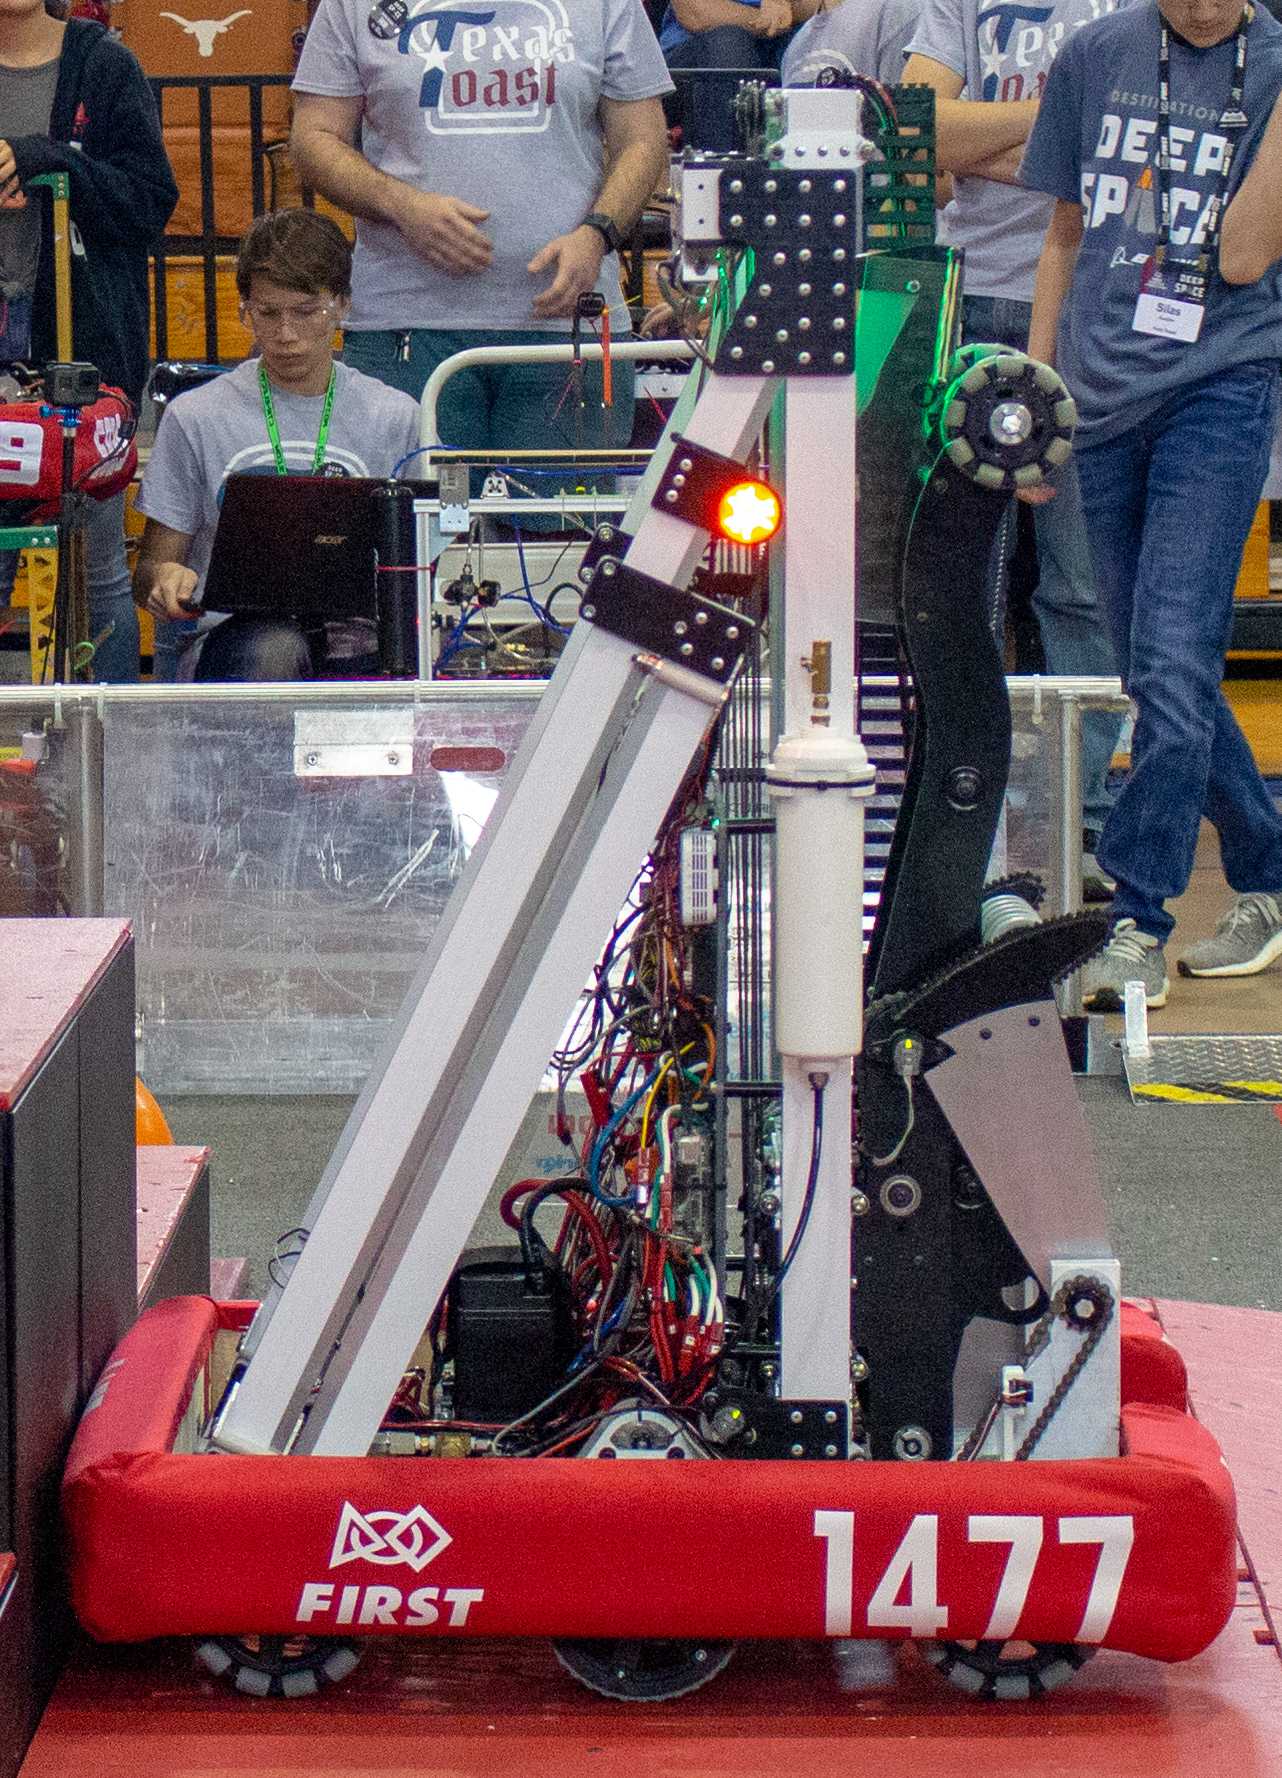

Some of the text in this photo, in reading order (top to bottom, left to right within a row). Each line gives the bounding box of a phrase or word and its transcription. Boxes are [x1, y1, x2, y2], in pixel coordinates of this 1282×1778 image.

[1096, 114, 1229, 177] DEEP
[296, 1582, 485, 1628] FIRST
[813, 1509, 1135, 1644] 1477
